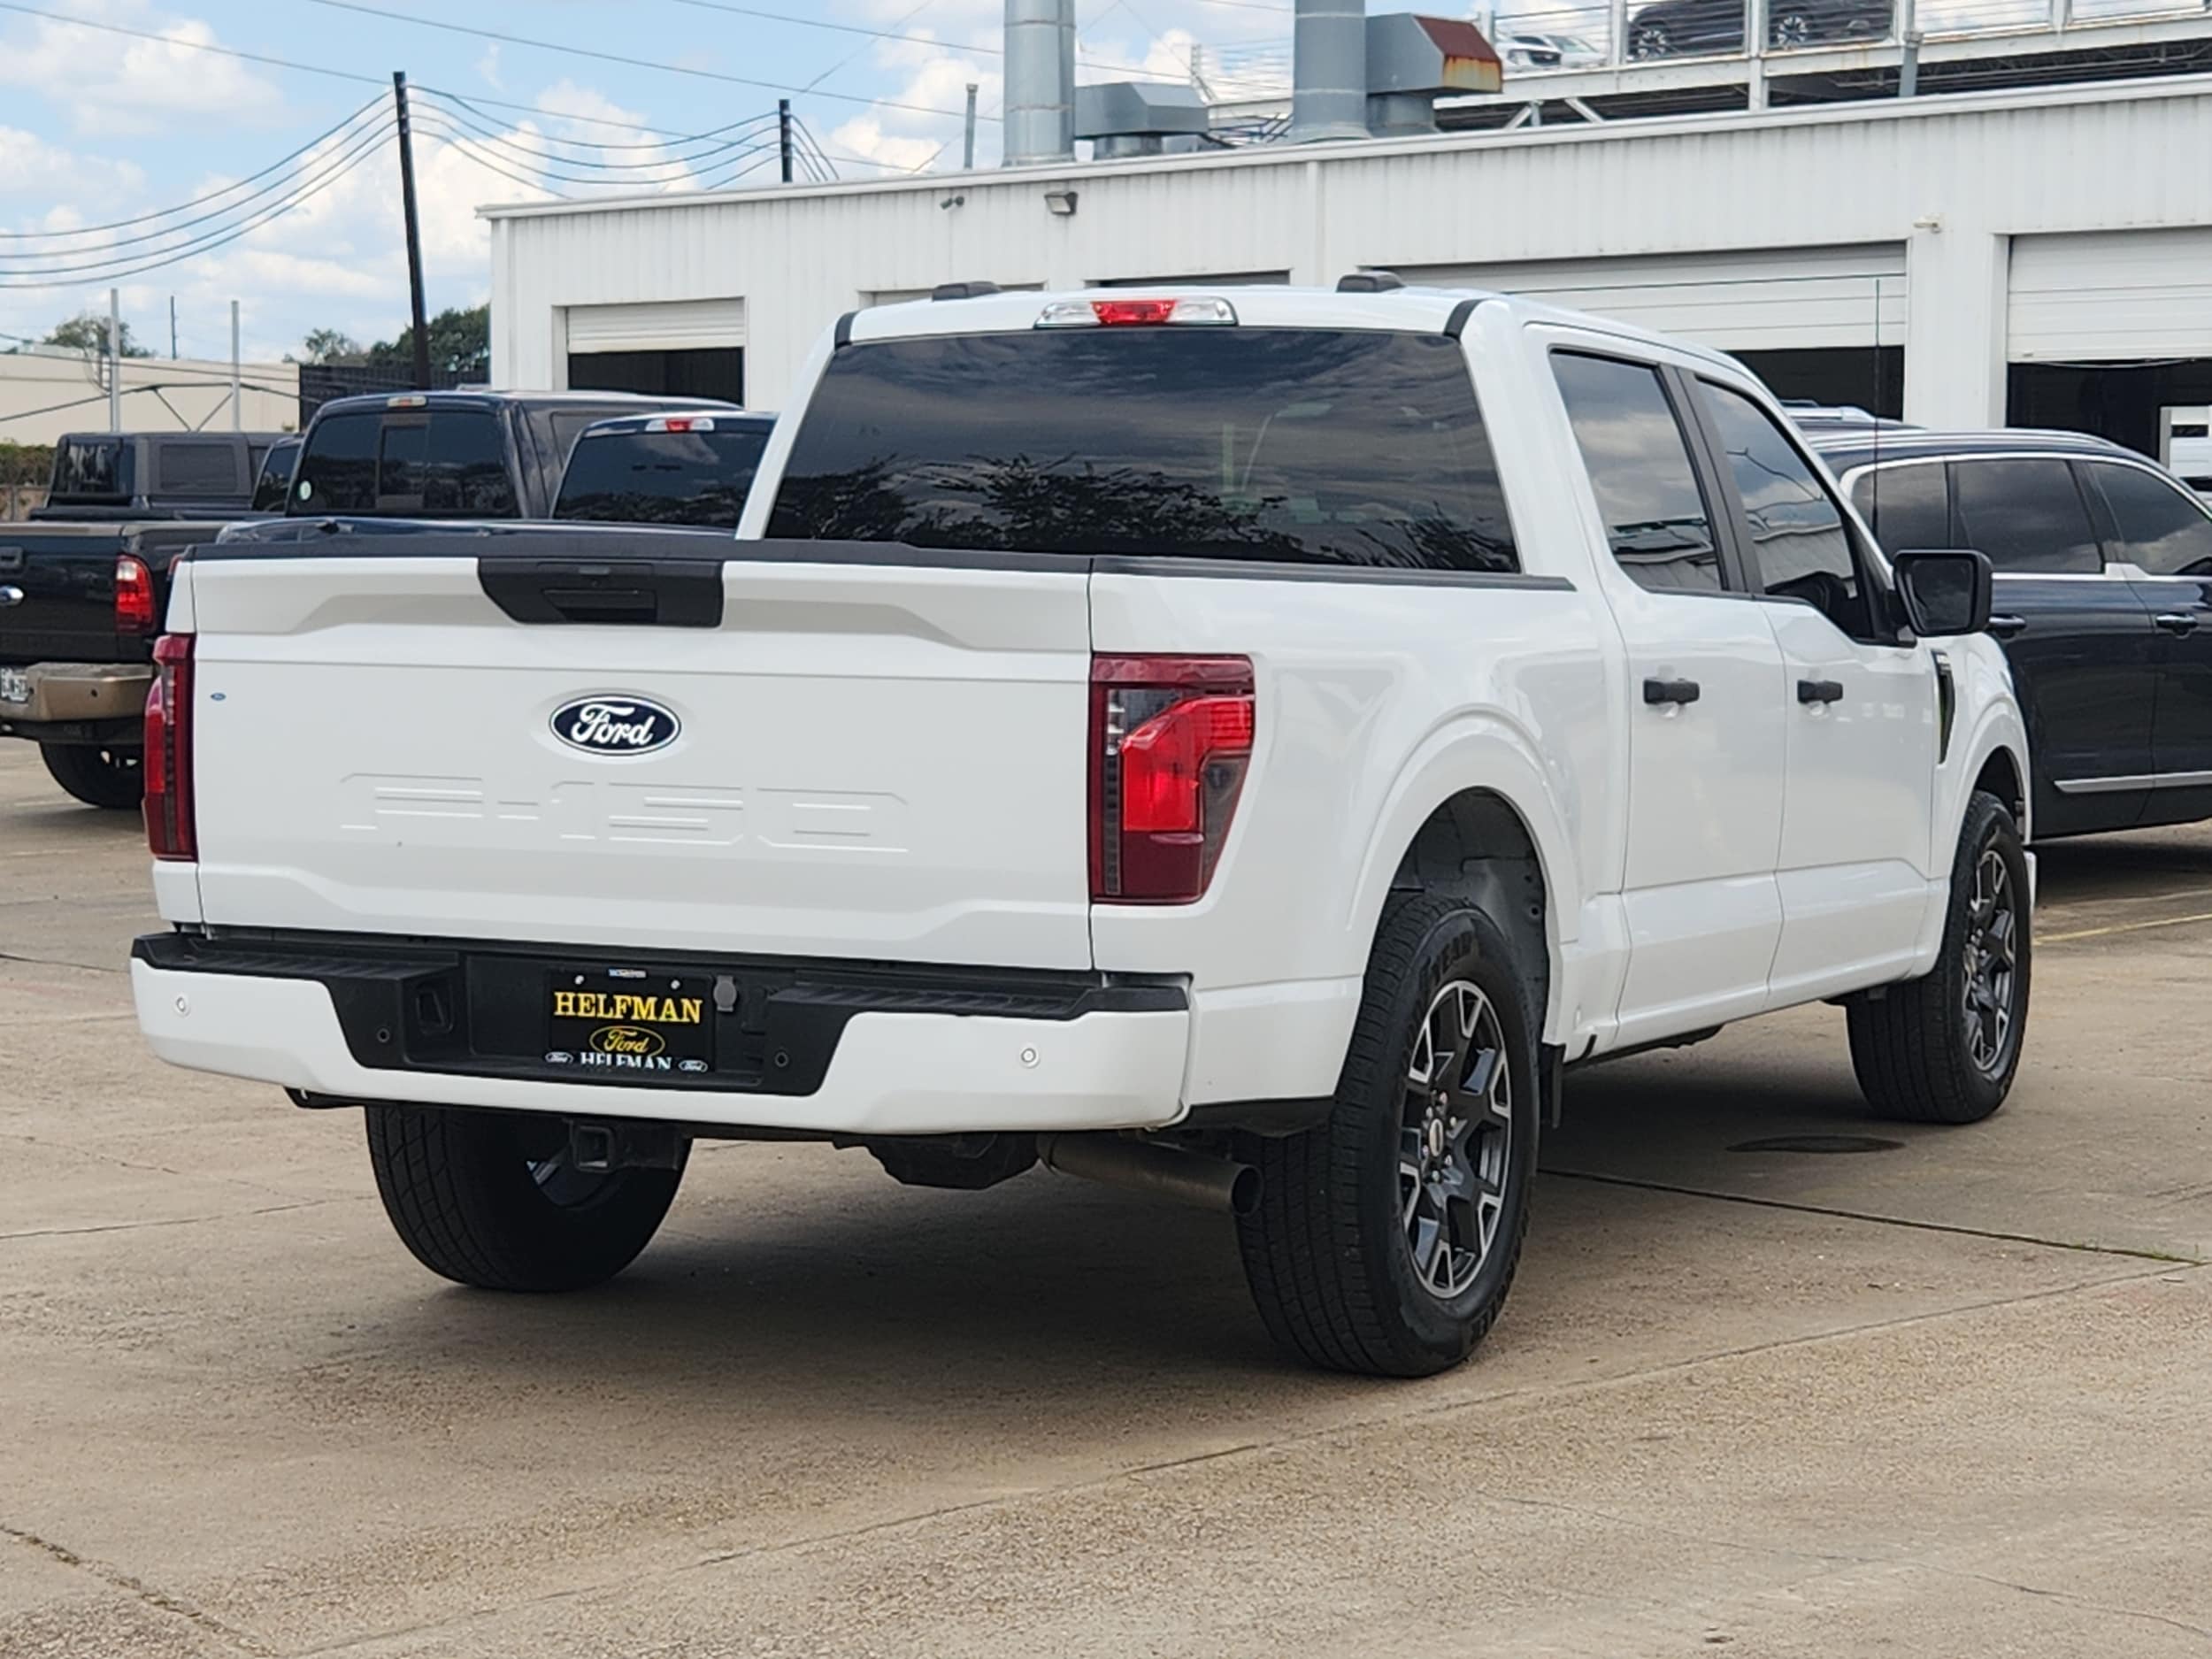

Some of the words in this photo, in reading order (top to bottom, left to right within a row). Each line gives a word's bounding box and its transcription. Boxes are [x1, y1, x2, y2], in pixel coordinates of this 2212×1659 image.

[571, 703, 657, 745] Ford
[554, 991, 703, 1024] HELFMAN
[603, 1029, 650, 1053] Ford
